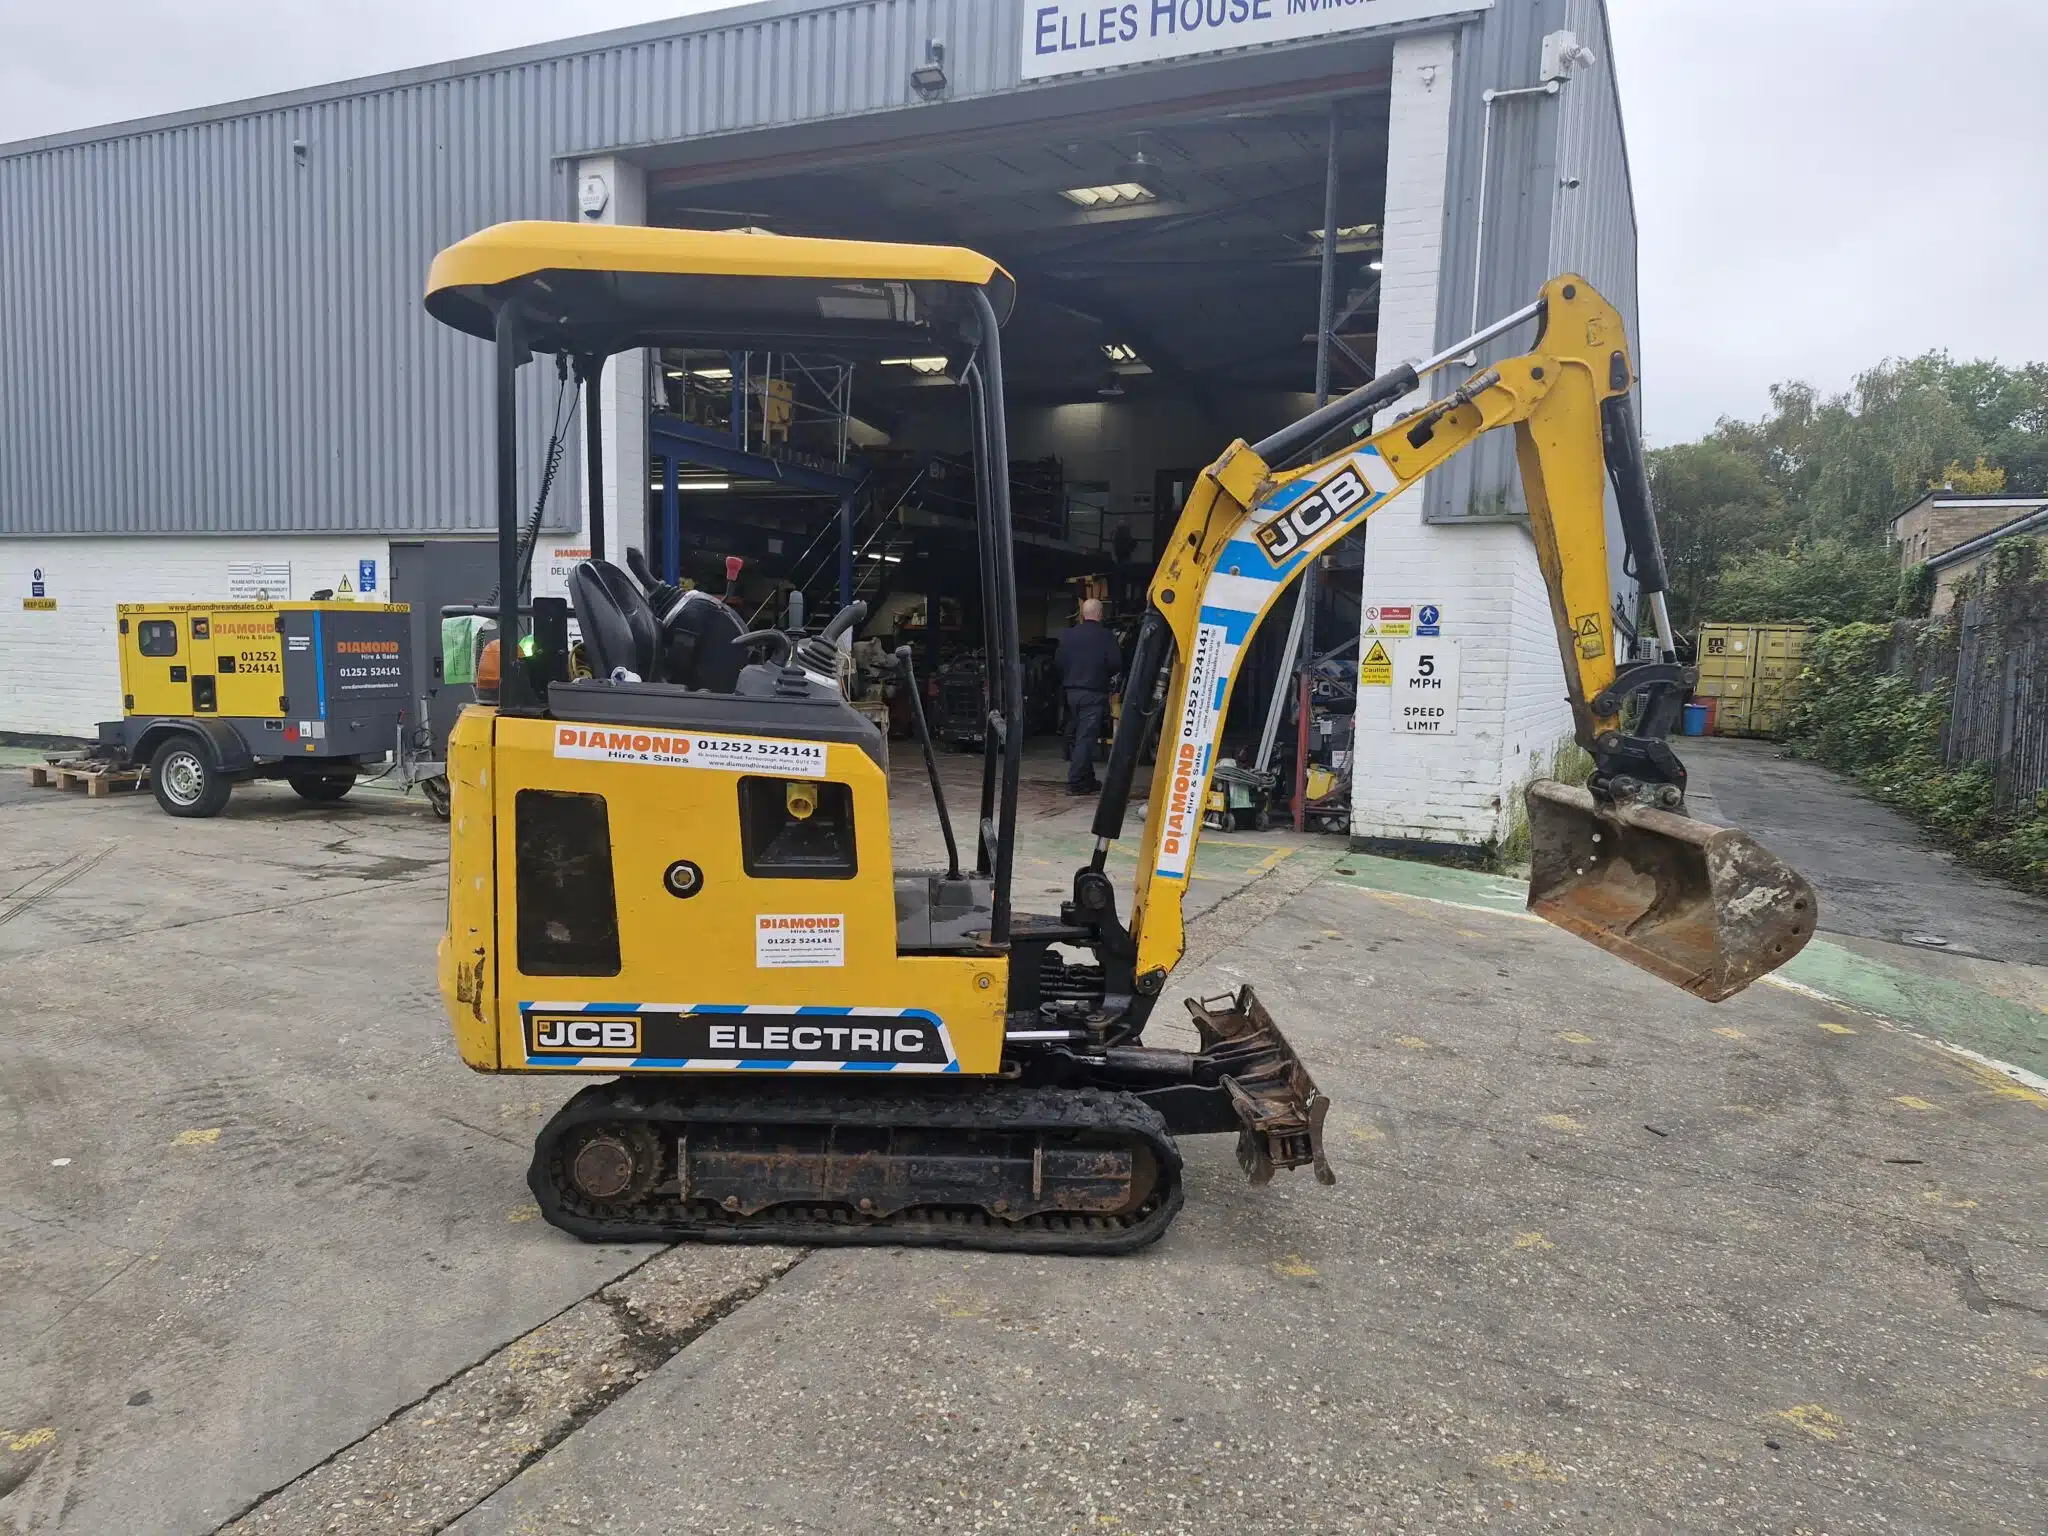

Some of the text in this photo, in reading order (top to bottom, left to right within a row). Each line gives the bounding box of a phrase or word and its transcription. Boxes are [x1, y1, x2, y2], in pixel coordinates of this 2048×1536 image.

[1150, 0, 1271, 37] HOUSE
[1269, 472, 1364, 556] JCB
[24, 601, 37, 609] KEEP
[119, 604, 130, 613] DG
[384, 604, 394, 612] DG
[215, 624, 275, 634] DIAMOND
[336, 641, 400, 653] DIAMOND
[241, 651, 277, 662] 01252
[239, 663, 281, 673] 524141
[340, 666, 401, 677] 01252 524141
[1418, 655, 1434, 676] 5
[1183, 628, 1210, 737] 01252 524141
[1410, 679, 1441, 689] MPH
[1404, 707, 1444, 717] SPEED
[1407, 721, 1440, 731] LIMIT
[559, 729, 690, 755] DIAMOND
[698, 740, 821, 758] 01252 524141
[608, 751, 689, 764] Hire & Sales
[709, 760, 809, 772] www.diamondhireandsales.co.uk
[1186, 745, 1204, 814] Hire & Sales
[1164, 743, 1195, 854] DIAMOND
[760, 918, 840, 929] DIAMOND
[539, 1022, 924, 1053] JCB ELECTRIC
